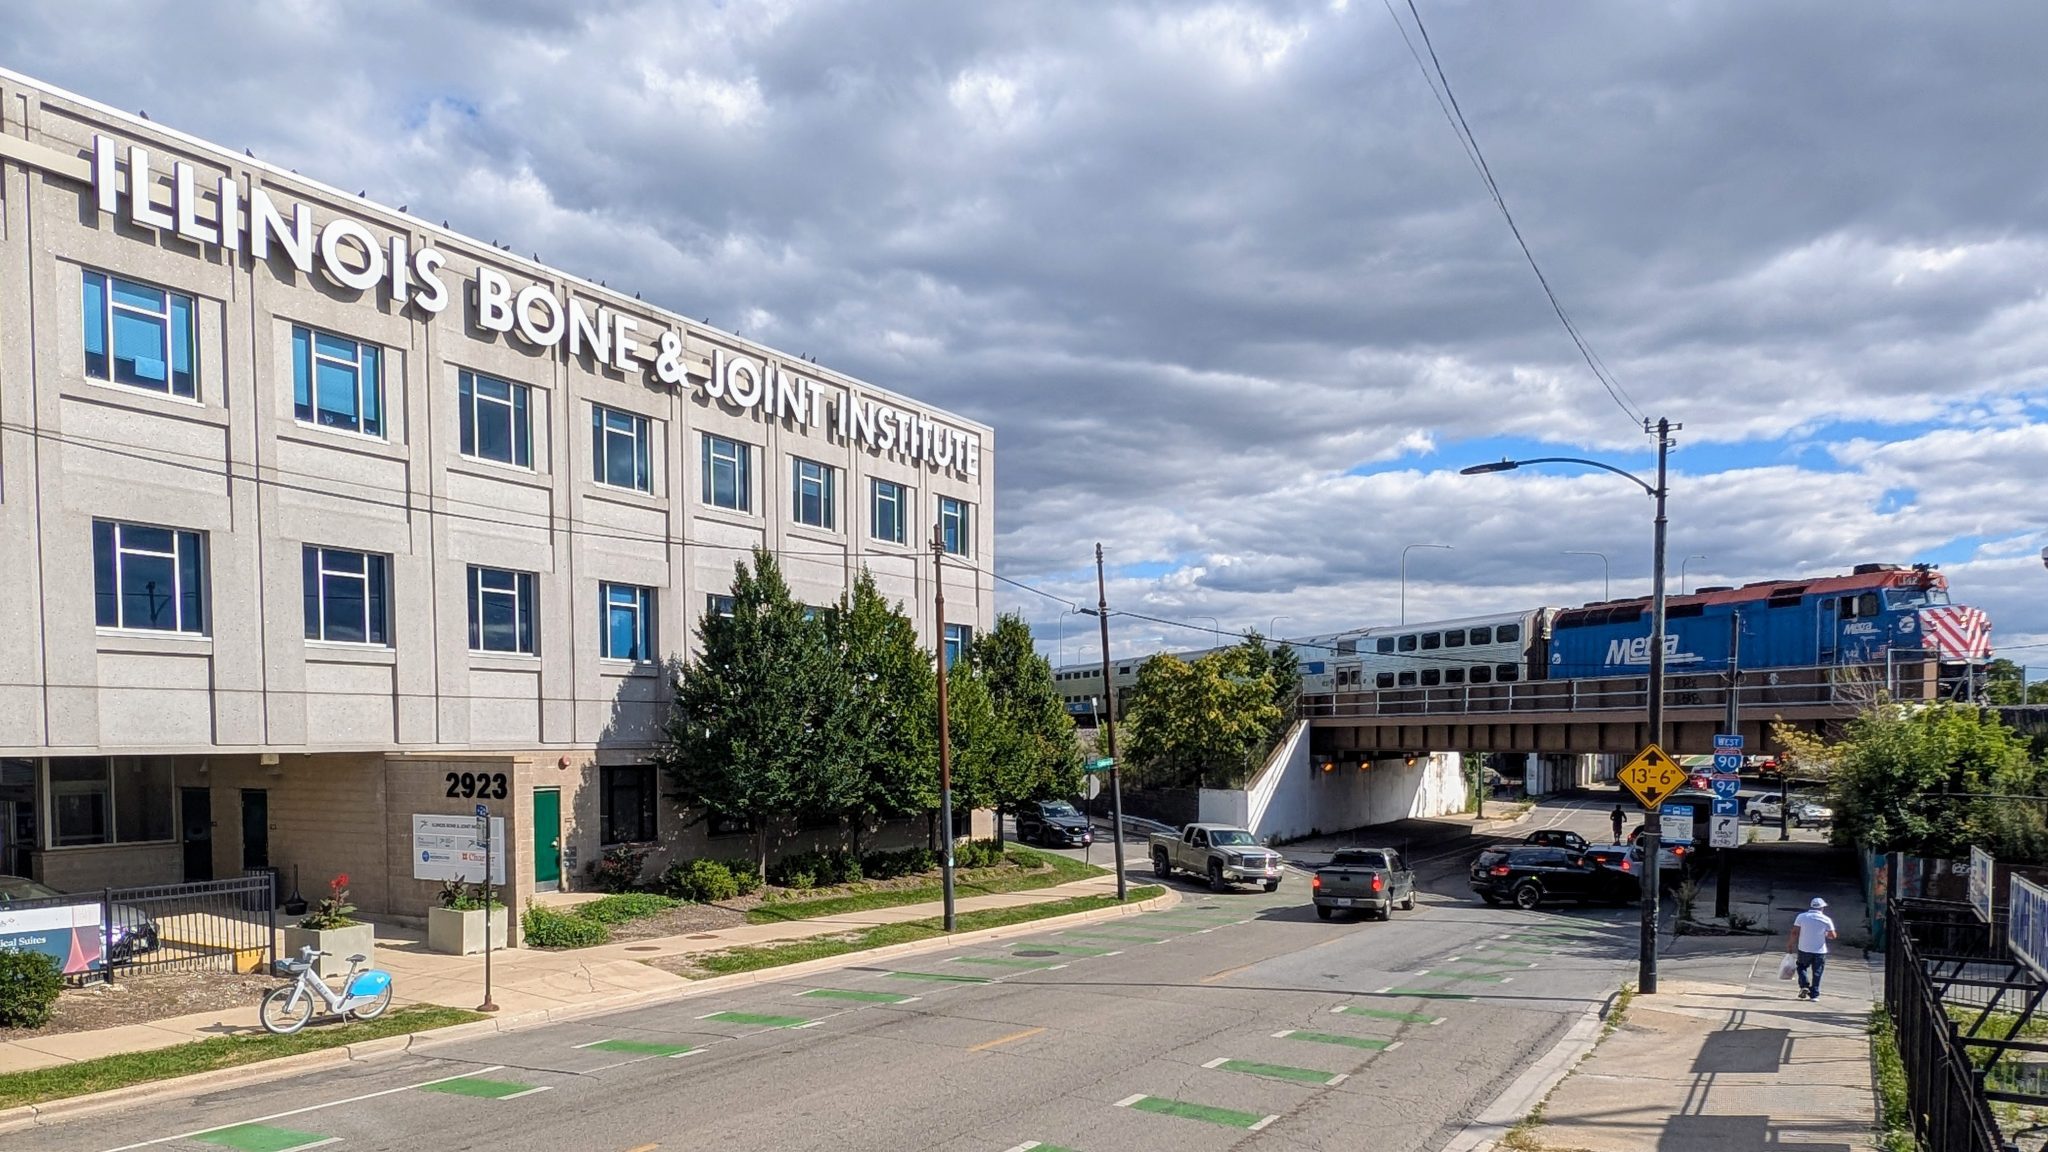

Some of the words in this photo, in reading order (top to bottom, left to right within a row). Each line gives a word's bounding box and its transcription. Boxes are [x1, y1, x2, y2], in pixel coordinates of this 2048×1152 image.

[94, 134, 449, 313] ILLINOIS
[476, 267, 640, 374] BONE
[655, 331, 690, 388] &
[704, 349, 825, 428] JOINT
[836, 391, 980, 476] INSTITUTE
[1604, 634, 1680, 665] Meta
[1718, 737, 1739, 746] WEST
[1718, 755, 1737, 768] 90
[445, 772, 508, 800] 2923
[1716, 780, 1736, 793] 94
[18, 936, 47, 946] Suites
